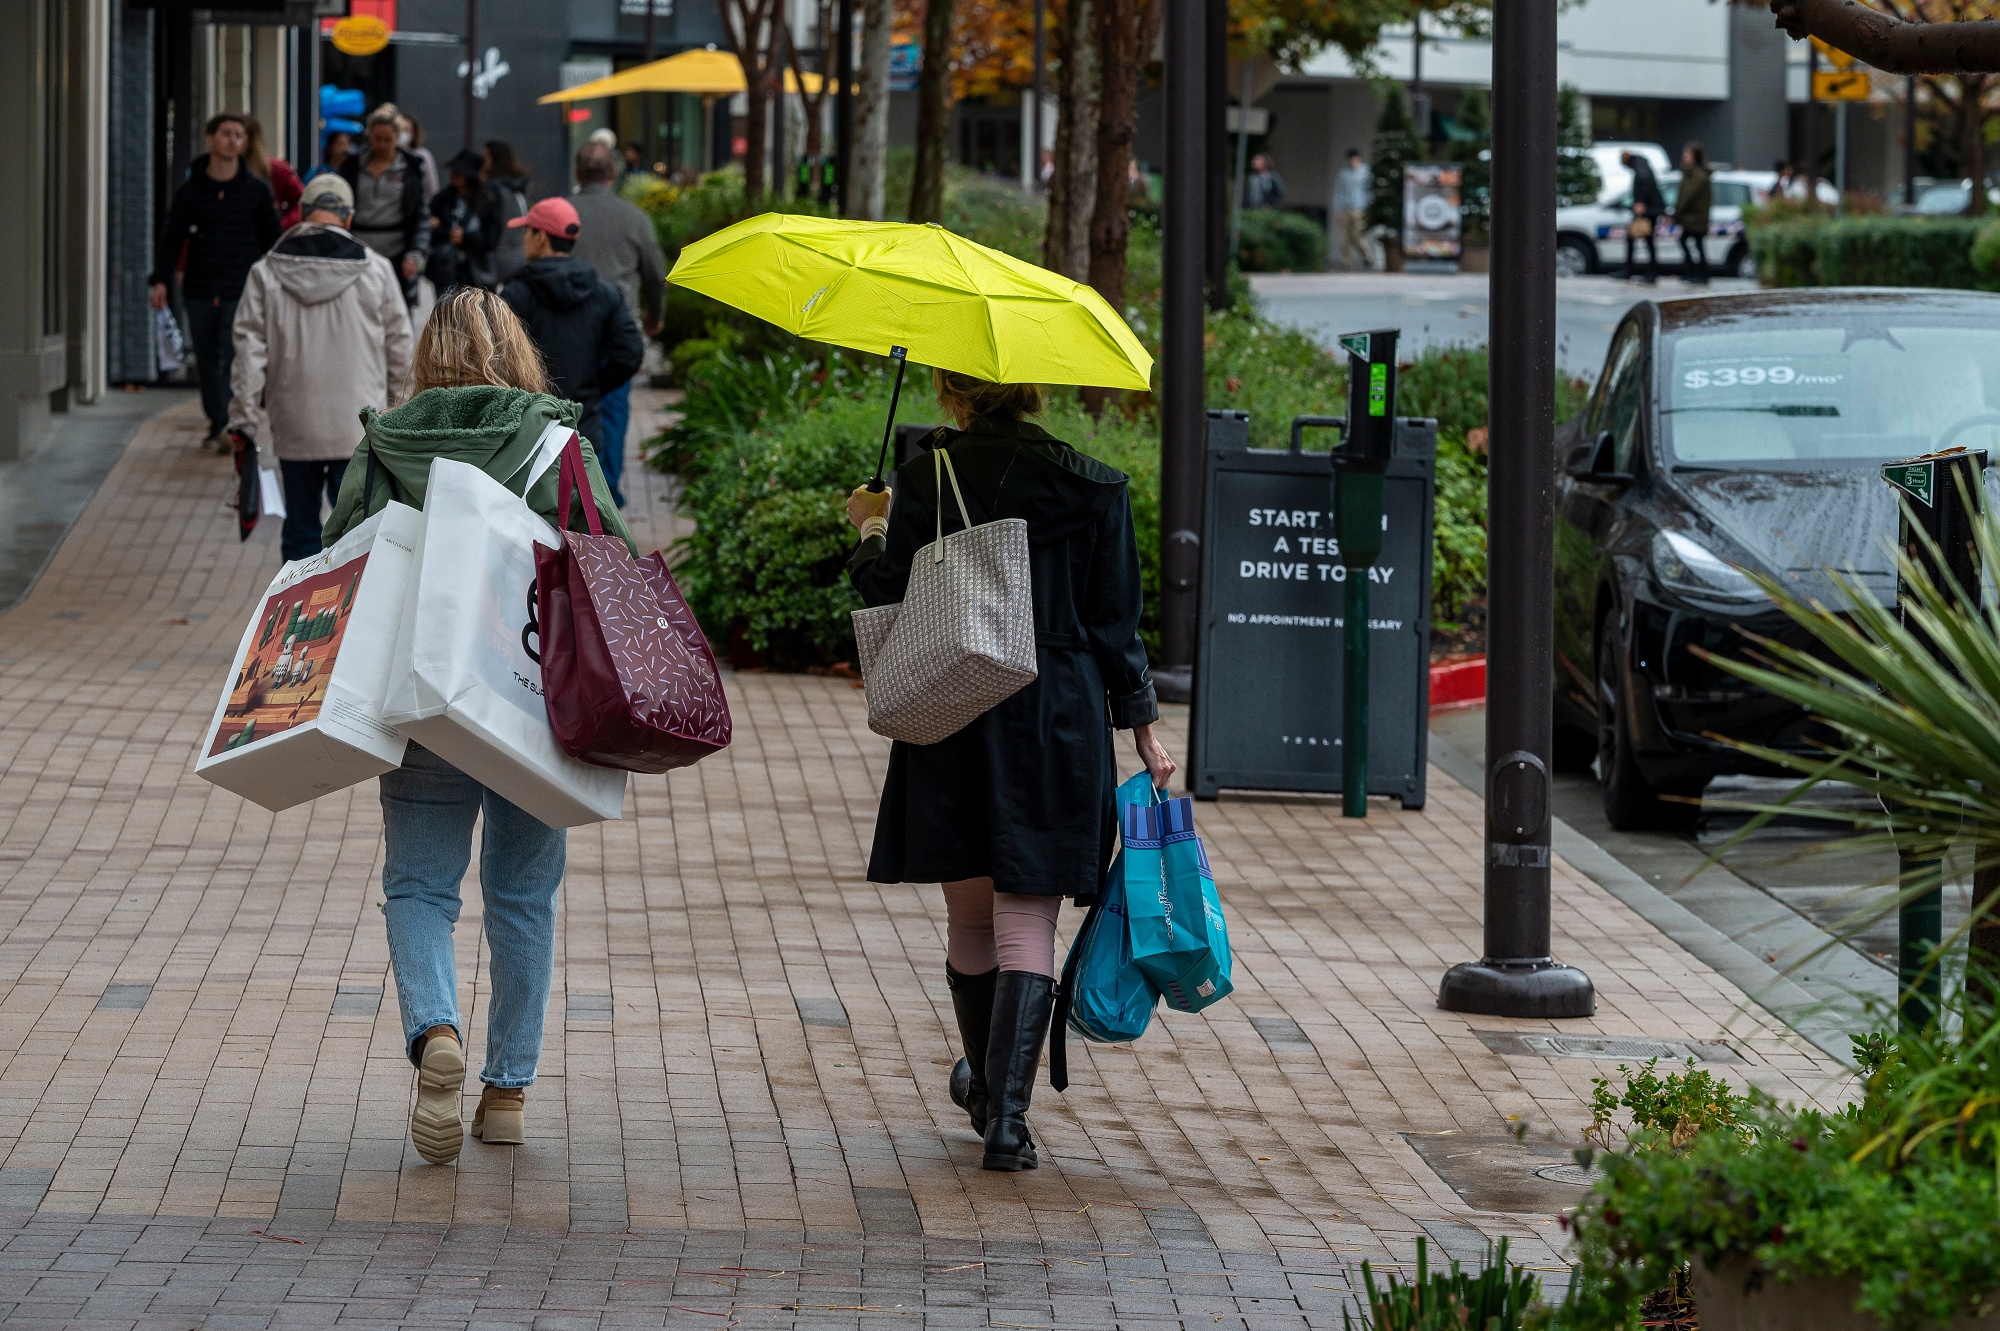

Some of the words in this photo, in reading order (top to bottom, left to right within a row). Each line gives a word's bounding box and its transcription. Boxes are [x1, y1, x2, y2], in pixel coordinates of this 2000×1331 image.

[1907, 477, 1912, 485] 3
[1249, 508, 1321, 528] START
[1273, 536, 1290, 554] A
[1298, 537, 1340, 556] TES
[1240, 560, 1310, 581] DRIVE
[1317, 564, 1394, 585] TOAY
[1227, 613, 1247, 624] NO
[1249, 614, 1332, 628] APPOINTMENT
[513, 670, 530, 689] THE
[1281, 735, 1343, 747] TESLA
